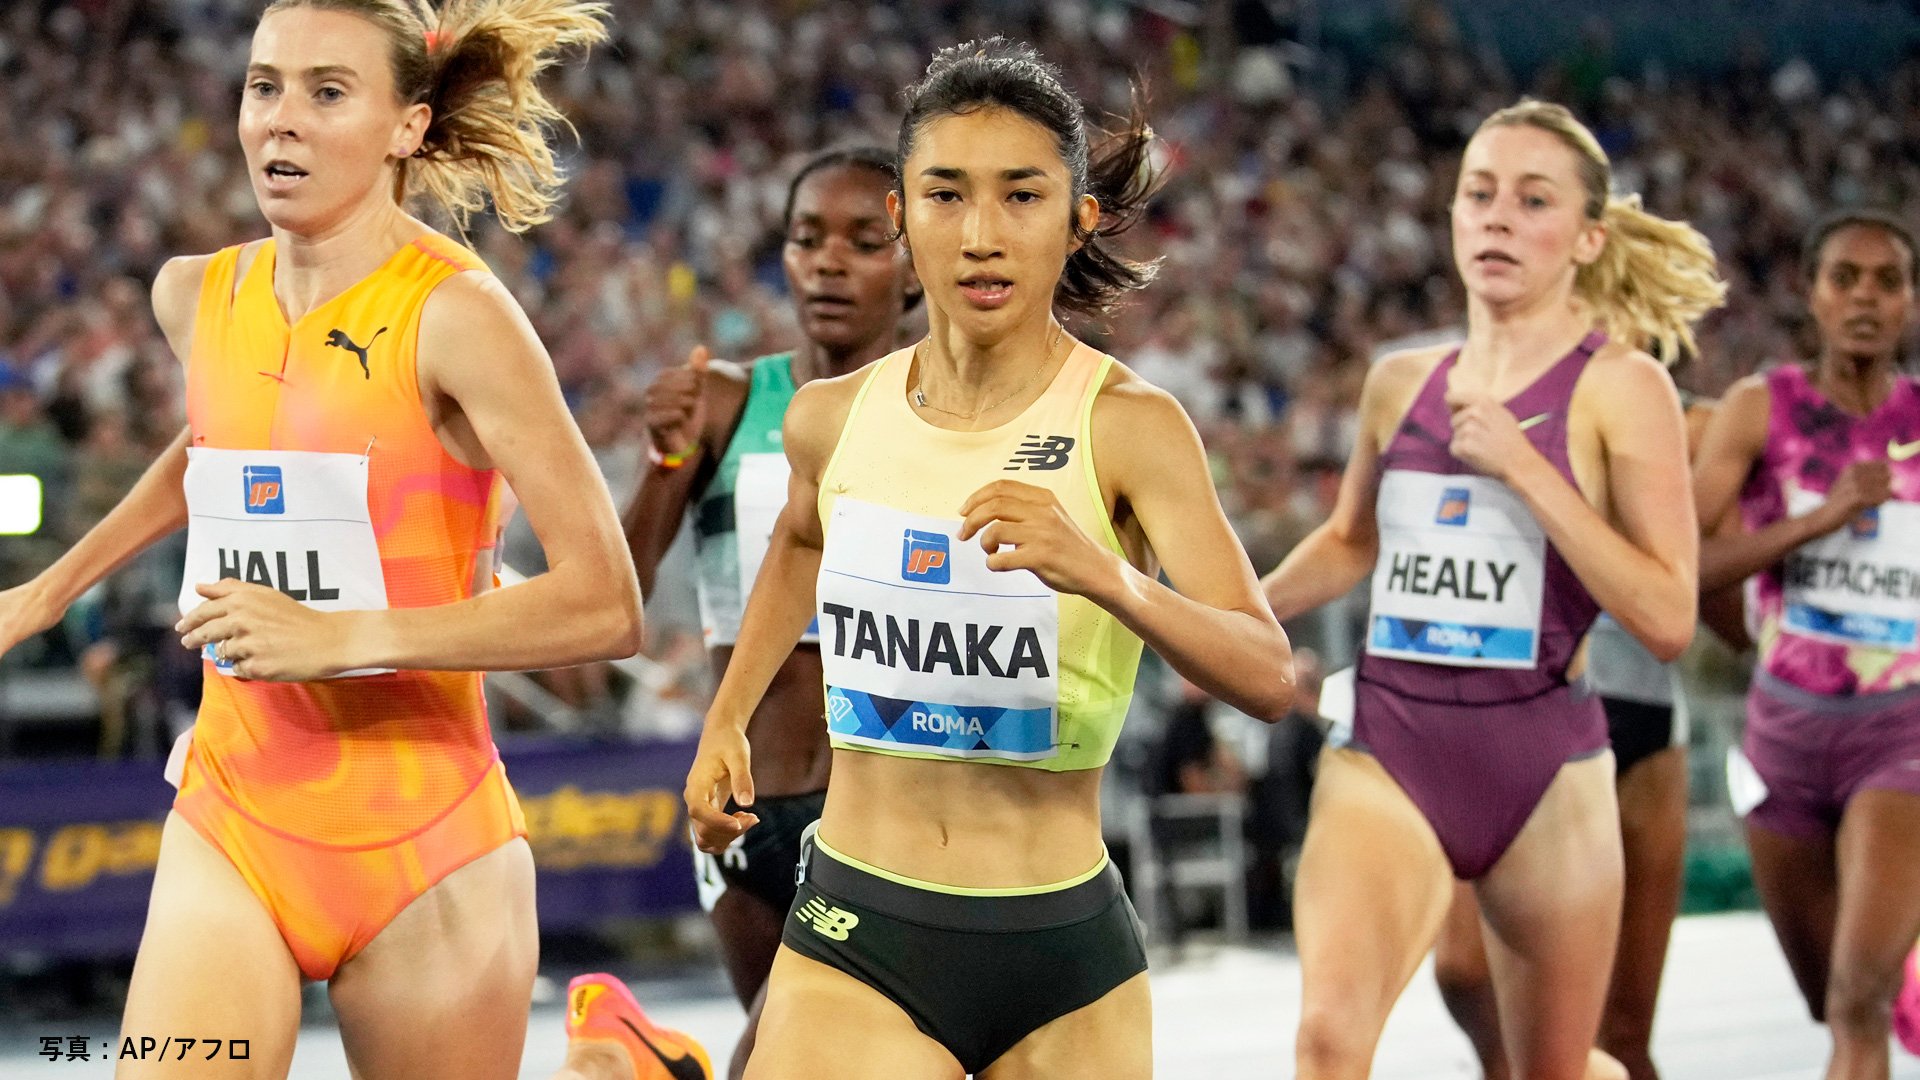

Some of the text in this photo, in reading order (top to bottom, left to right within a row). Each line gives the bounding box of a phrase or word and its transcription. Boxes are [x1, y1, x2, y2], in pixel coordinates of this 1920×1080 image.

[217, 547, 340, 601] HALL
[905, 548, 947, 575] IP
[1387, 552, 1518, 603] HEALY
[822, 601, 1050, 679] TANAKA
[1425, 625, 1483, 647] ROMA
[911, 710, 985, 736] ROMA
